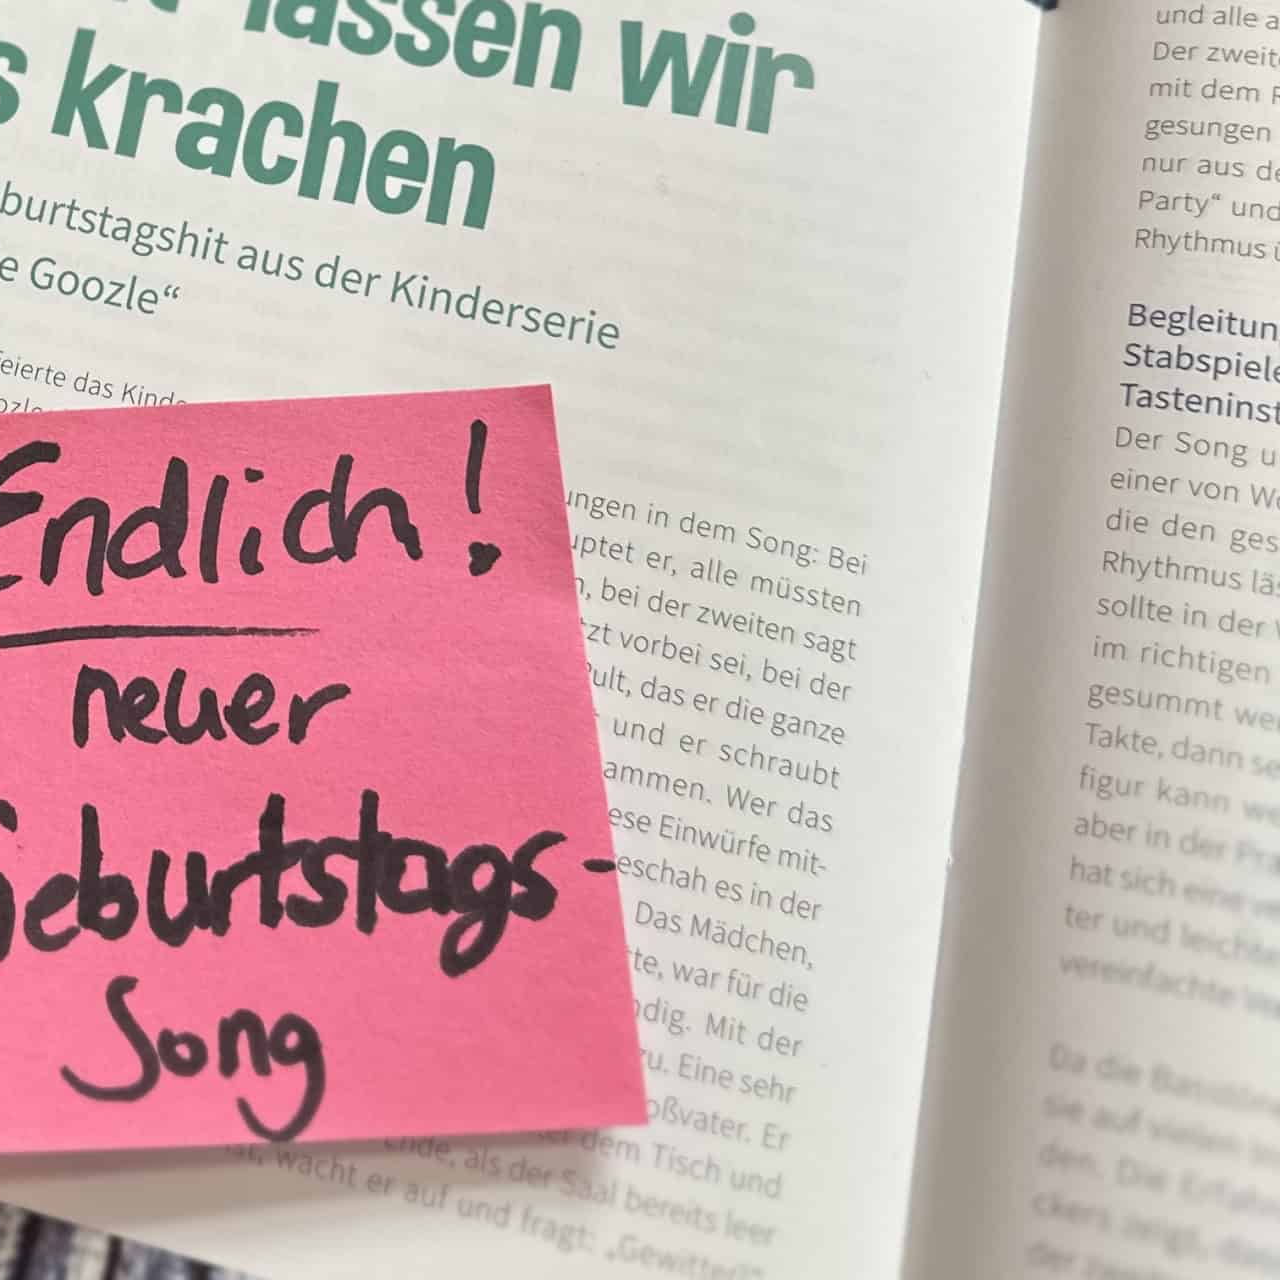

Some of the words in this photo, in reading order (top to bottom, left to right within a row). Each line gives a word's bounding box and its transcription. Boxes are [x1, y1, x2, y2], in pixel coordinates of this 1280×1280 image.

[1156, 5, 1204, 26] und
[1213, 6, 1258, 29] alle
[619, 11, 815, 136] wir
[1153, 42, 1199, 61] Der
[1149, 78, 1192, 98] mit
[1201, 79, 1259, 103] dem
[50, 28, 497, 229] krachen
[1144, 119, 1271, 144] gesungen
[1142, 154, 1186, 173] nur
[1197, 158, 1244, 178] aus
[1135, 228, 1266, 259] Rhythmus
[28, 257, 181, 316] Goozle“
[235, 241, 305, 285] aus
[313, 251, 382, 301] der
[389, 270, 621, 353] Kinderserie
[74, 372, 113, 399] das
[1115, 426, 1162, 451] Der
[1174, 431, 1248, 468] Song
[1110, 470, 1180, 493] einer
[1188, 478, 1239, 503] von
[647, 503, 670, 527] in
[679, 512, 736, 544] dem
[746, 527, 819, 567] Song:
[828, 546, 868, 575] Bei
[1105, 508, 1148, 533] die
[1162, 514, 1215, 542] den
[646, 549, 676, 576] er,
[690, 558, 738, 587] alle
[750, 572, 861, 616] müssten
[1101, 550, 1241, 590] Rhythmus
[601, 579, 639, 608] bei
[648, 590, 690, 619] der
[697, 605, 795, 644] zweiten
[803, 631, 856, 663] sagt
[1096, 594, 1172, 623] sollte
[1183, 604, 1207, 628] in
[1218, 610, 1267, 639] der
[620, 630, 701, 665] vorbei
[710, 651, 752, 681] sei,
[762, 658, 800, 689] bei
[810, 672, 851, 702] der
[1140, 642, 1270, 685] richtigen
[72, 665, 351, 748] neuer
[640, 676, 684, 706] das
[693, 693, 719, 713] er
[725, 696, 764, 725] die
[771, 710, 846, 745] ganze
[613, 719, 665, 746] und
[679, 733, 707, 755] er
[719, 741, 839, 790] schraubt
[726, 783, 776, 817] Wer
[788, 801, 832, 833] das
[659, 817, 770, 863] Einwürfe
[778, 841, 827, 876] mit-
[715, 878, 742, 902] es
[750, 882, 771, 909] in
[780, 888, 822, 921] der
[635, 900, 681, 934] Das
[690, 913, 814, 971] Mädchen,
[673, 959, 720, 990] war
[727, 969, 761, 1001] für
[769, 984, 809, 1013] die
[61, 977, 326, 1142] Song
[705, 1013, 746, 1046] Mit
[757, 1024, 802, 1058] der
[677, 1053, 735, 1089] Eine
[739, 1071, 797, 1104] sehr
[762, 1122, 790, 1152] Er
[652, 1142, 721, 1184] Tisch
[729, 1166, 781, 1199] und
